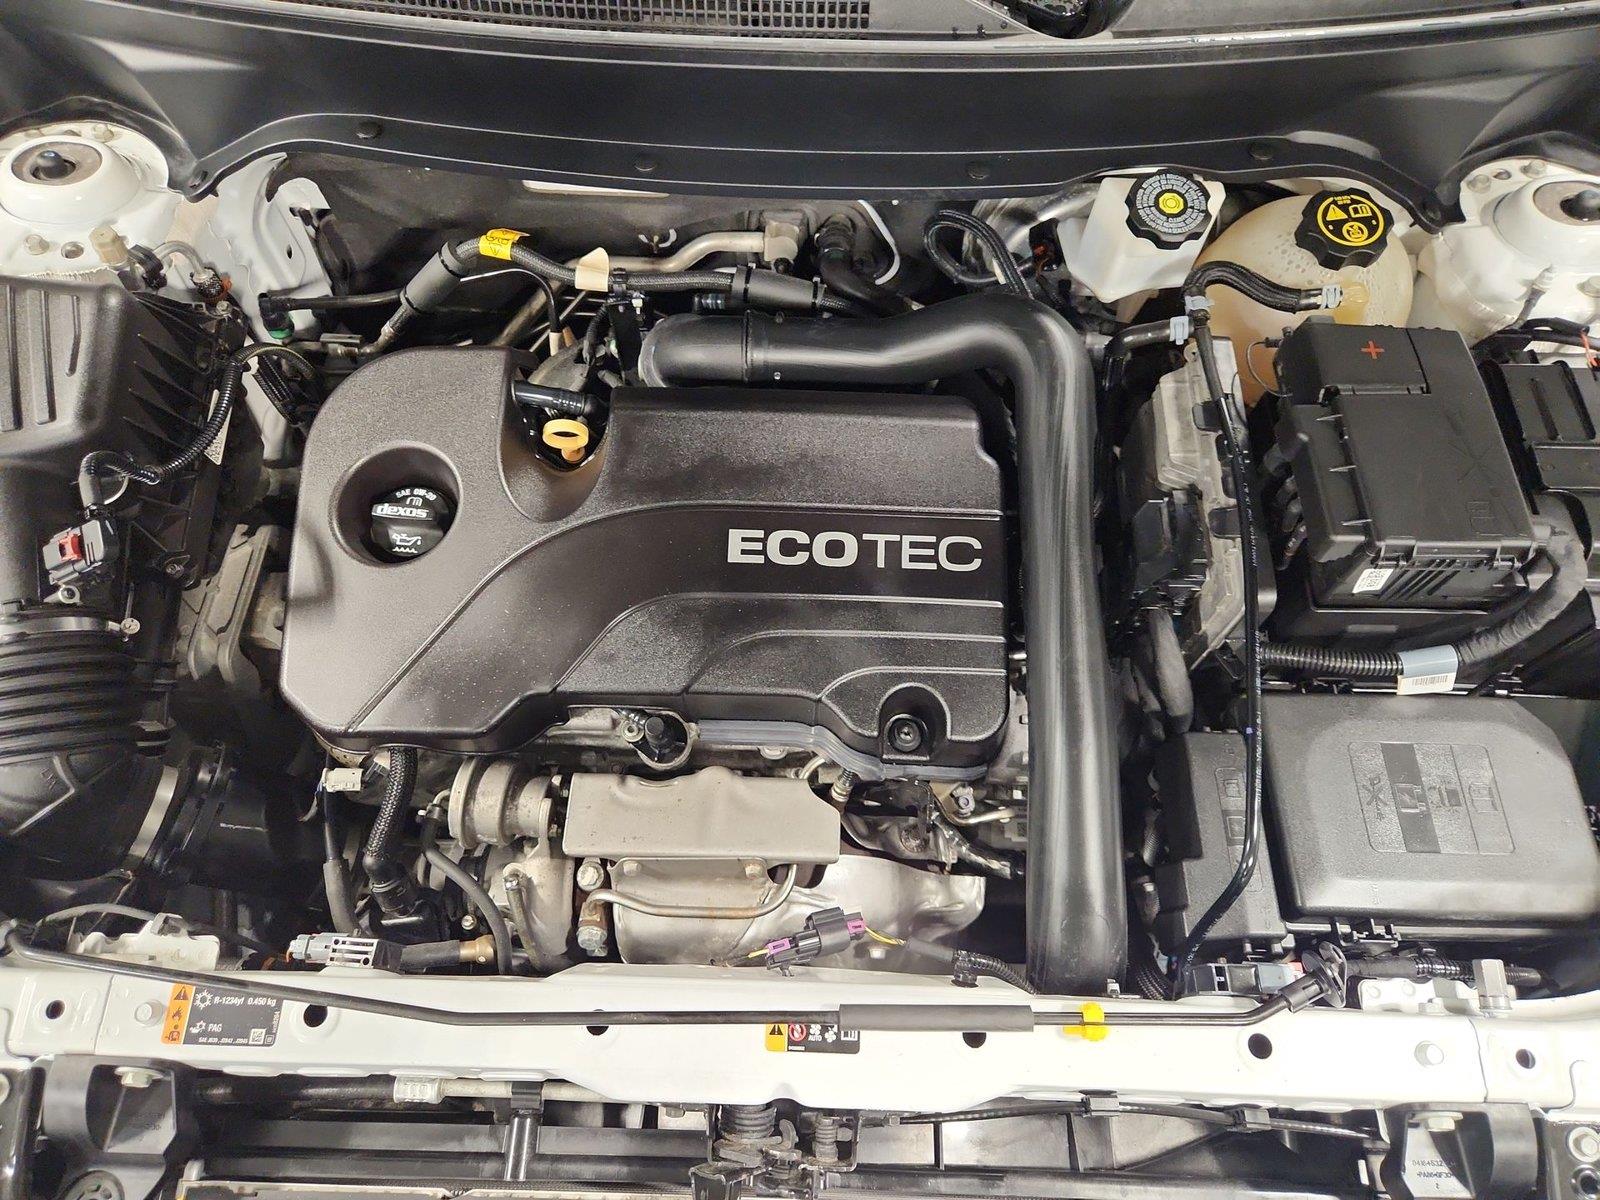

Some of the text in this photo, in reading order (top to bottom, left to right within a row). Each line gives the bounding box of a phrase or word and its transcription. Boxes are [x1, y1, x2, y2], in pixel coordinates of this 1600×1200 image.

[395, 488, 411, 498] SAE
[377, 503, 429, 518] dexos
[727, 528, 982, 572] ECOTEC
[213, 996, 245, 1007] R-1234yf
[266, 998, 277, 1007] kg
[207, 1023, 223, 1033] PAG
